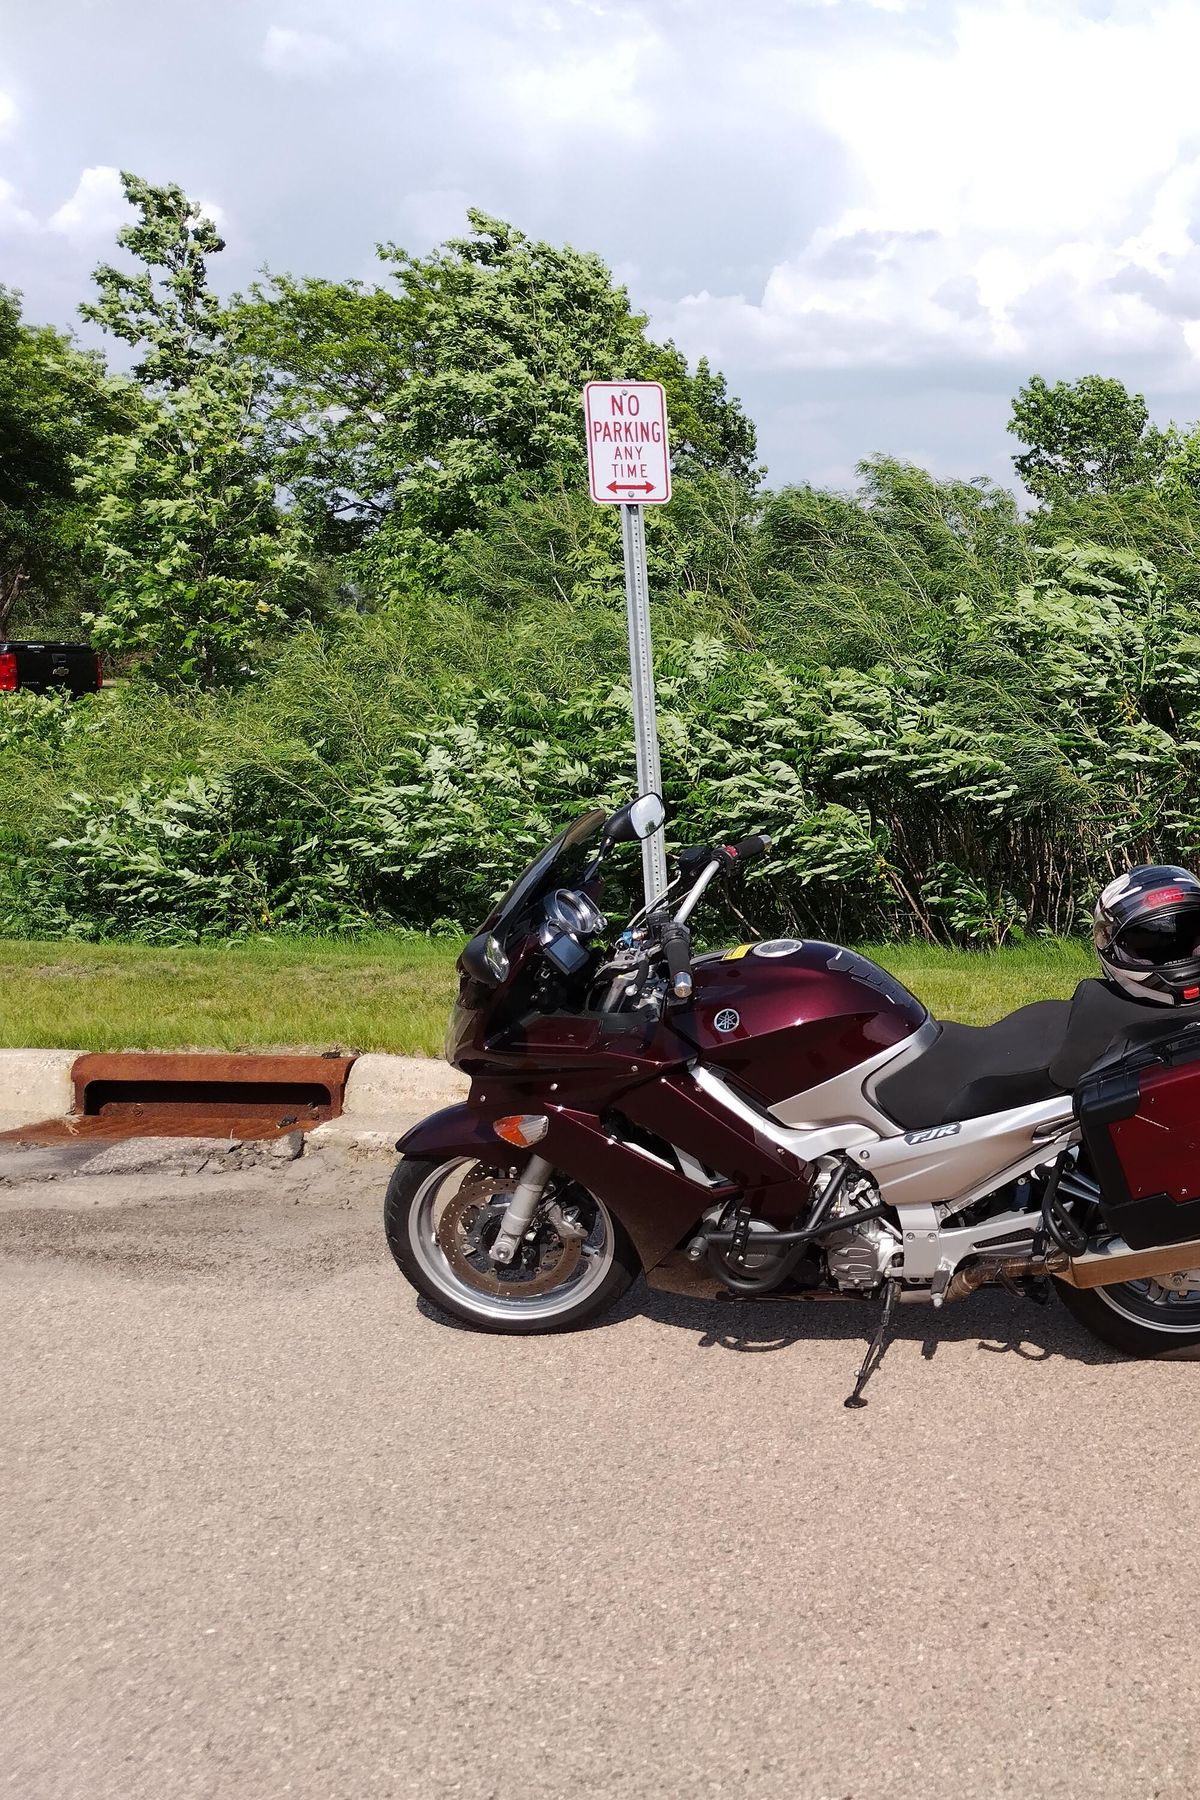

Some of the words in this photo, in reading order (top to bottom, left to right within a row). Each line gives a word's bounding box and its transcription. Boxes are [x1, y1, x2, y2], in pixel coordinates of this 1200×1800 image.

[611, 395, 640, 417] NO
[593, 421, 661, 443] PARKING
[614, 446, 643, 460] ANY
[611, 463, 648, 478] TIME
[909, 1124, 958, 1144] FJR
